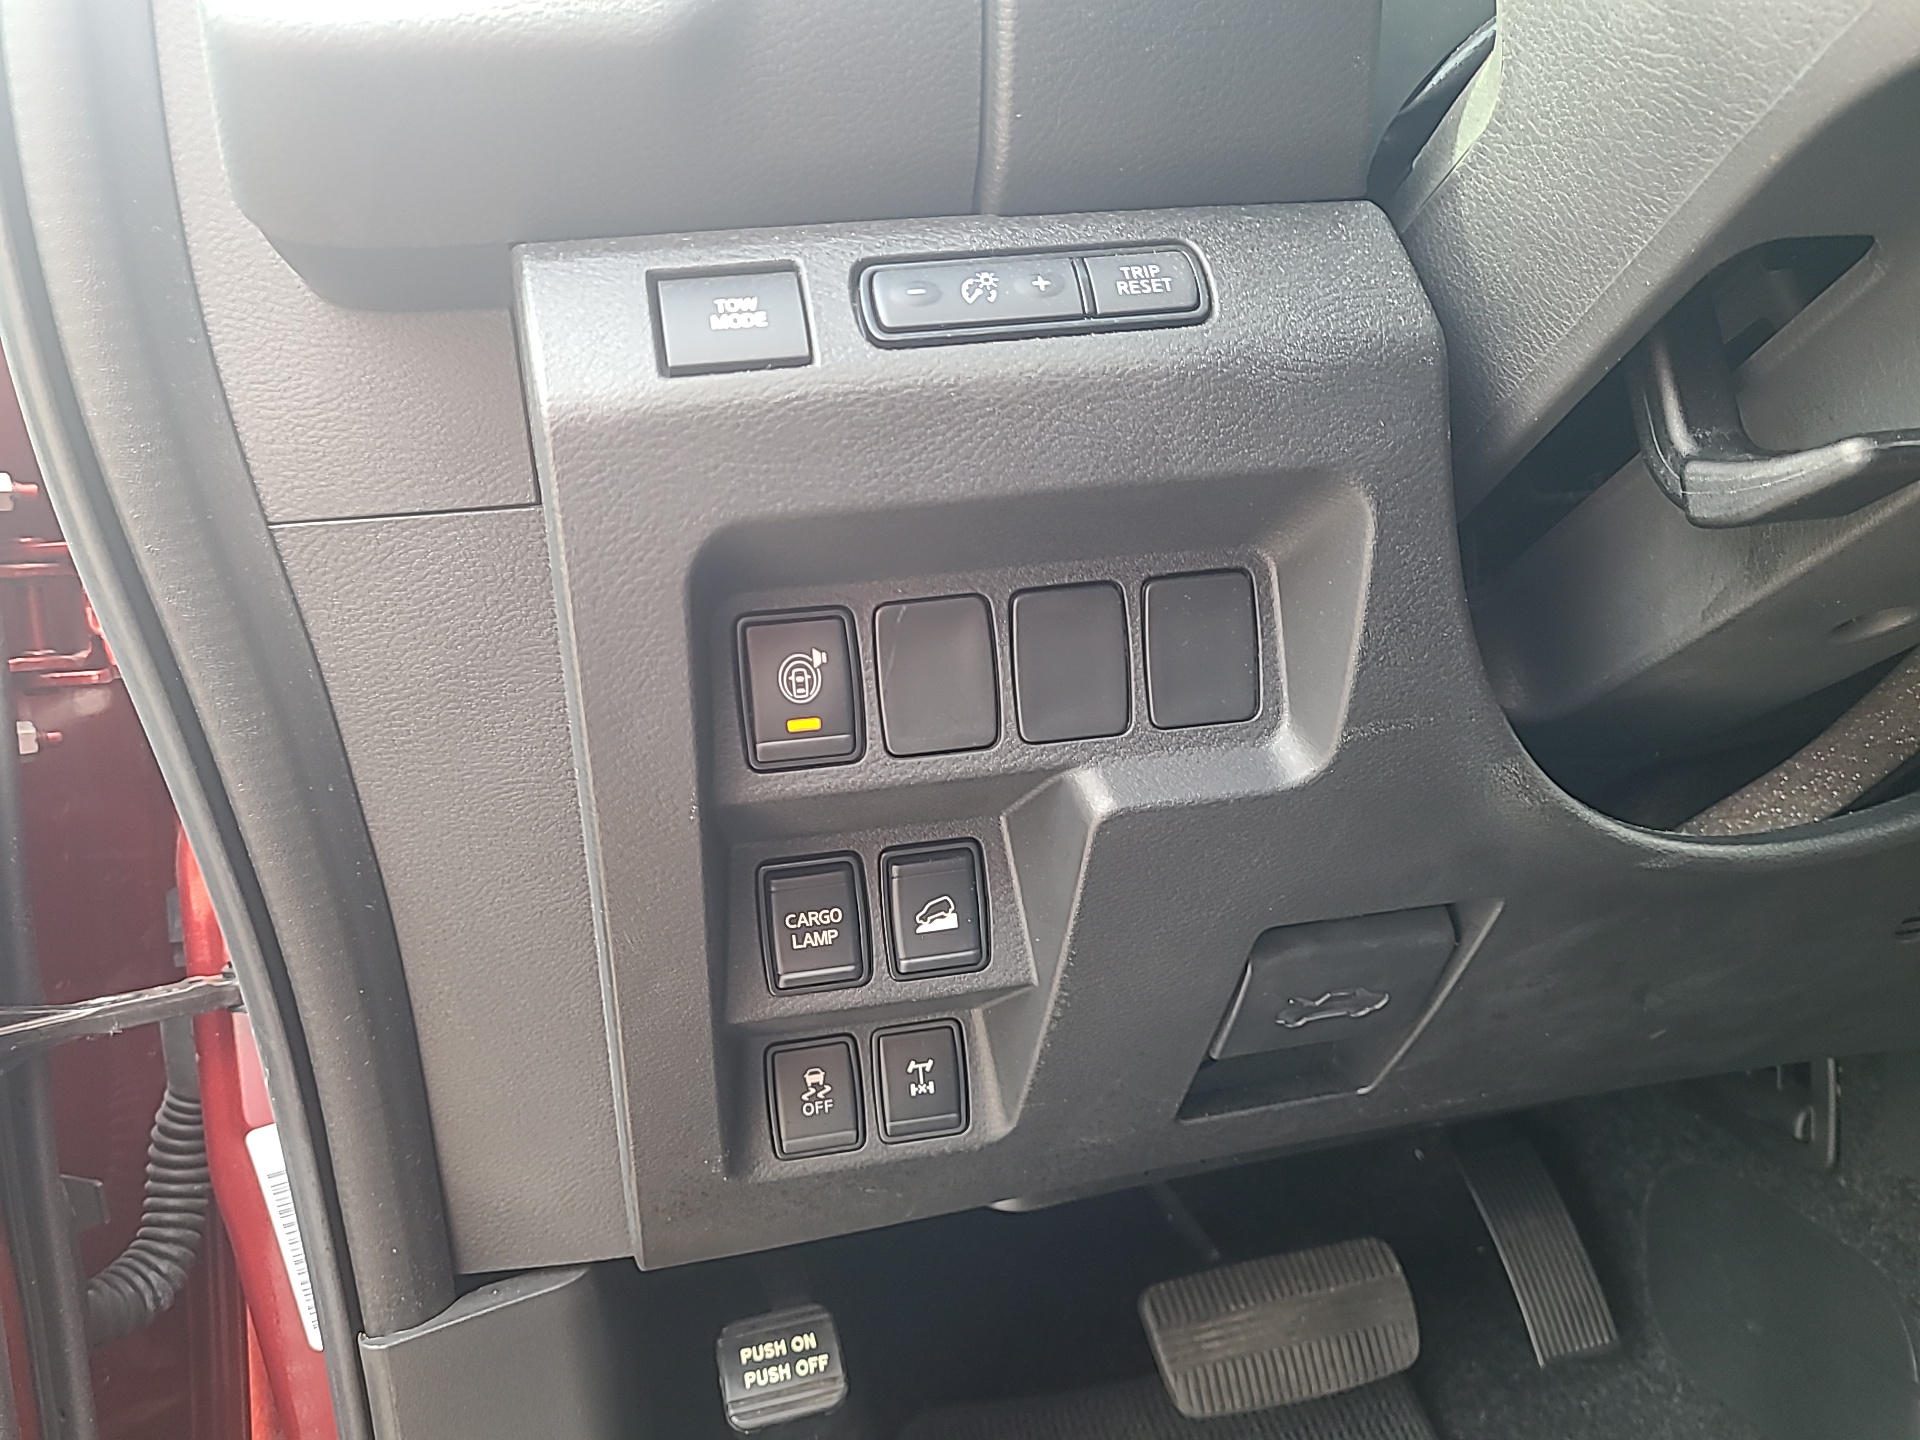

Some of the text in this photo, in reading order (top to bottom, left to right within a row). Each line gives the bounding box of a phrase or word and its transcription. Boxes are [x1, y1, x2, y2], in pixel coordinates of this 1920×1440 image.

[1119, 264, 1160, 280] TRIP
[1116, 278, 1172, 295] RESET
[713, 297, 758, 314] TOW
[709, 310, 769, 330] MODE
[785, 907, 843, 929] CARGO
[791, 929, 839, 949] LAMP
[802, 1099, 834, 1116] OFF
[739, 1332, 817, 1366] PUSH ON
[744, 1353, 829, 1390] PUSH OFF
